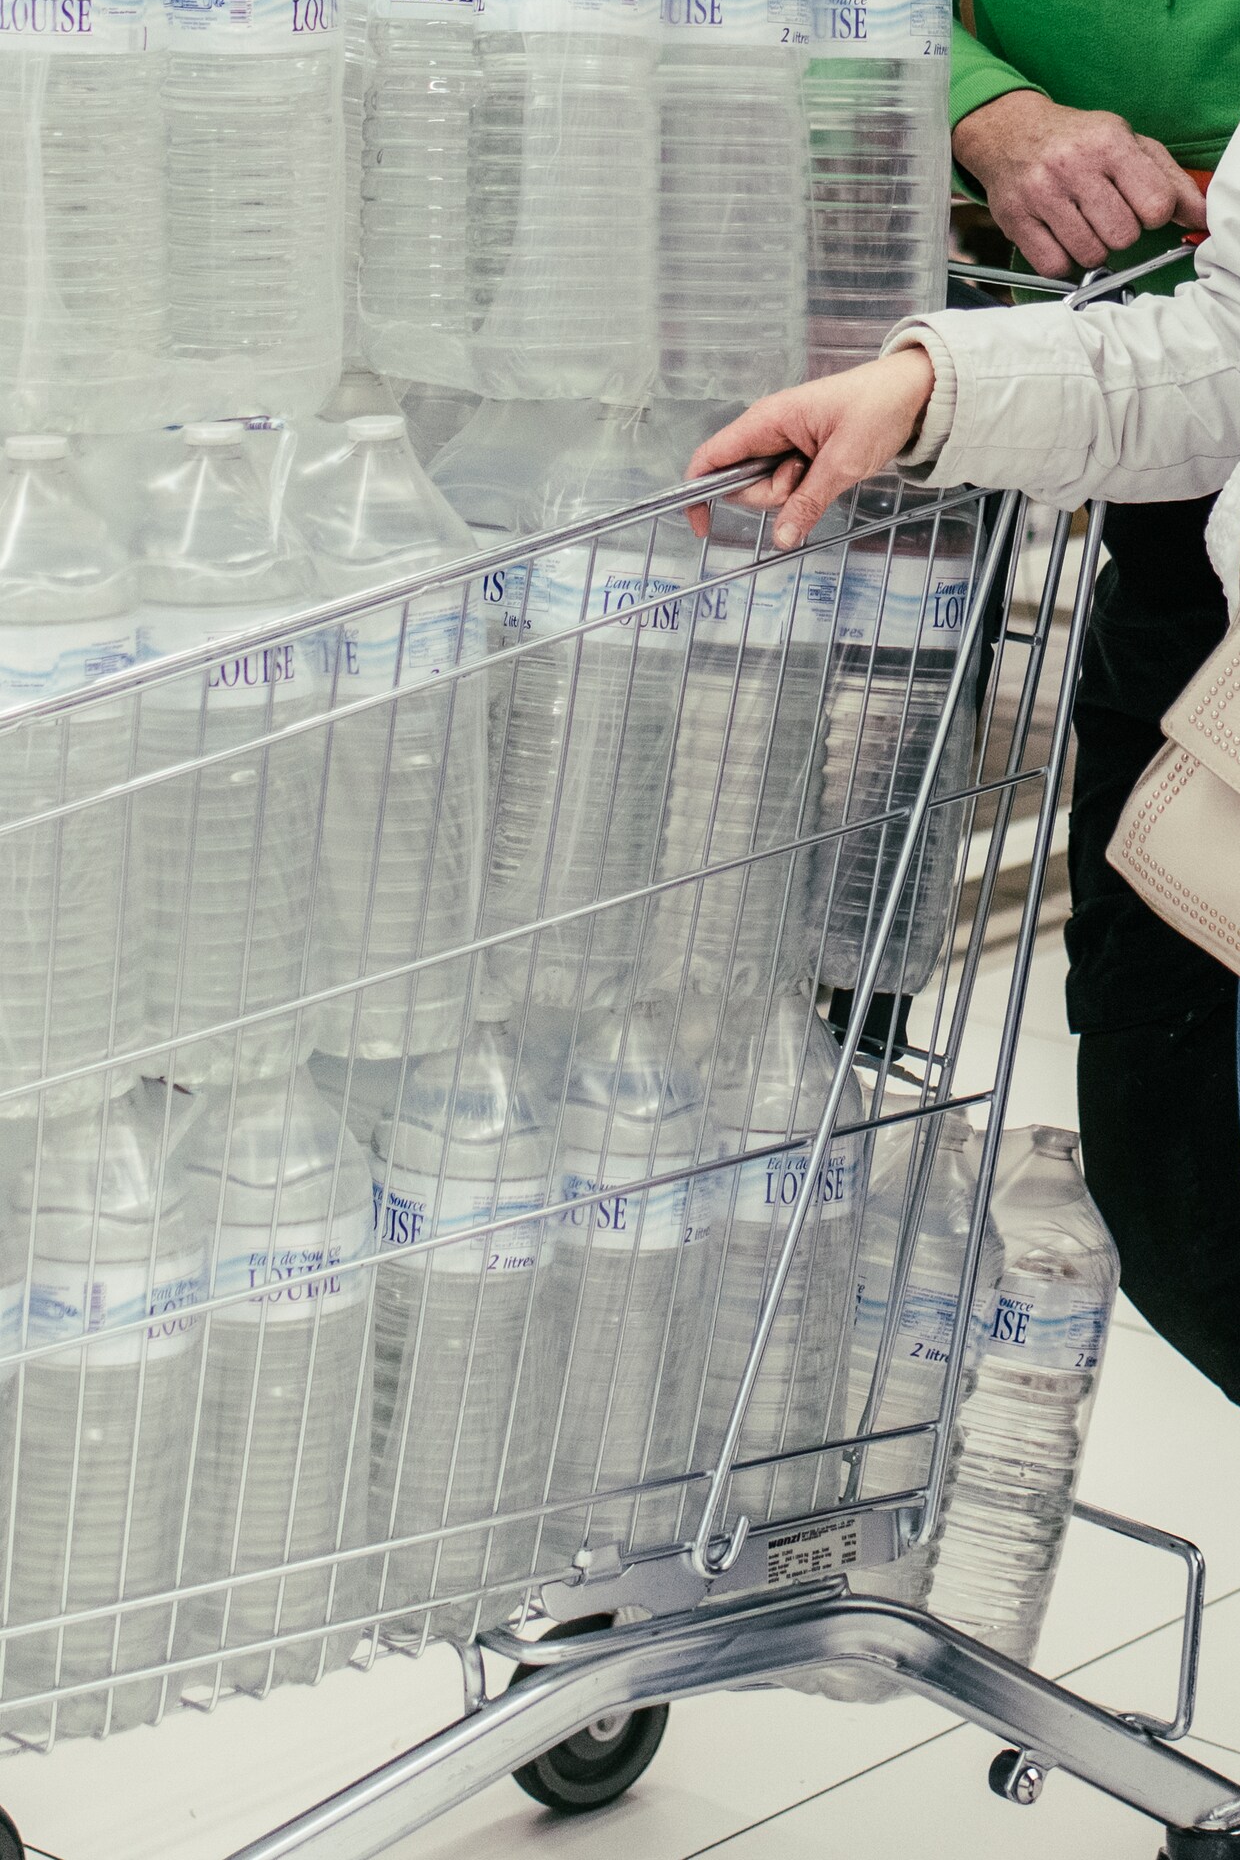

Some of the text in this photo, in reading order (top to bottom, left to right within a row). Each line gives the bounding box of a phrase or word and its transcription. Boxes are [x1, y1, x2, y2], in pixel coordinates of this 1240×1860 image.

[781, 27, 791, 43] 2
[923, 40, 932, 55] 2
[604, 574, 632, 591] Eau
[935, 581, 955, 595] Eau
[508, 615, 532, 630] lites
[765, 1167, 845, 1205] LOISE
[390, 1192, 427, 1212] Source
[684, 1227, 693, 1243] 2
[280, 1250, 297, 1265] de
[487, 1253, 535, 1270] 2 litres
[999, 1296, 1035, 1313] ource
[909, 1341, 924, 1358] 2
[1074, 1352, 1085, 1368] 2
[768, 1532, 801, 1550] wanzl
